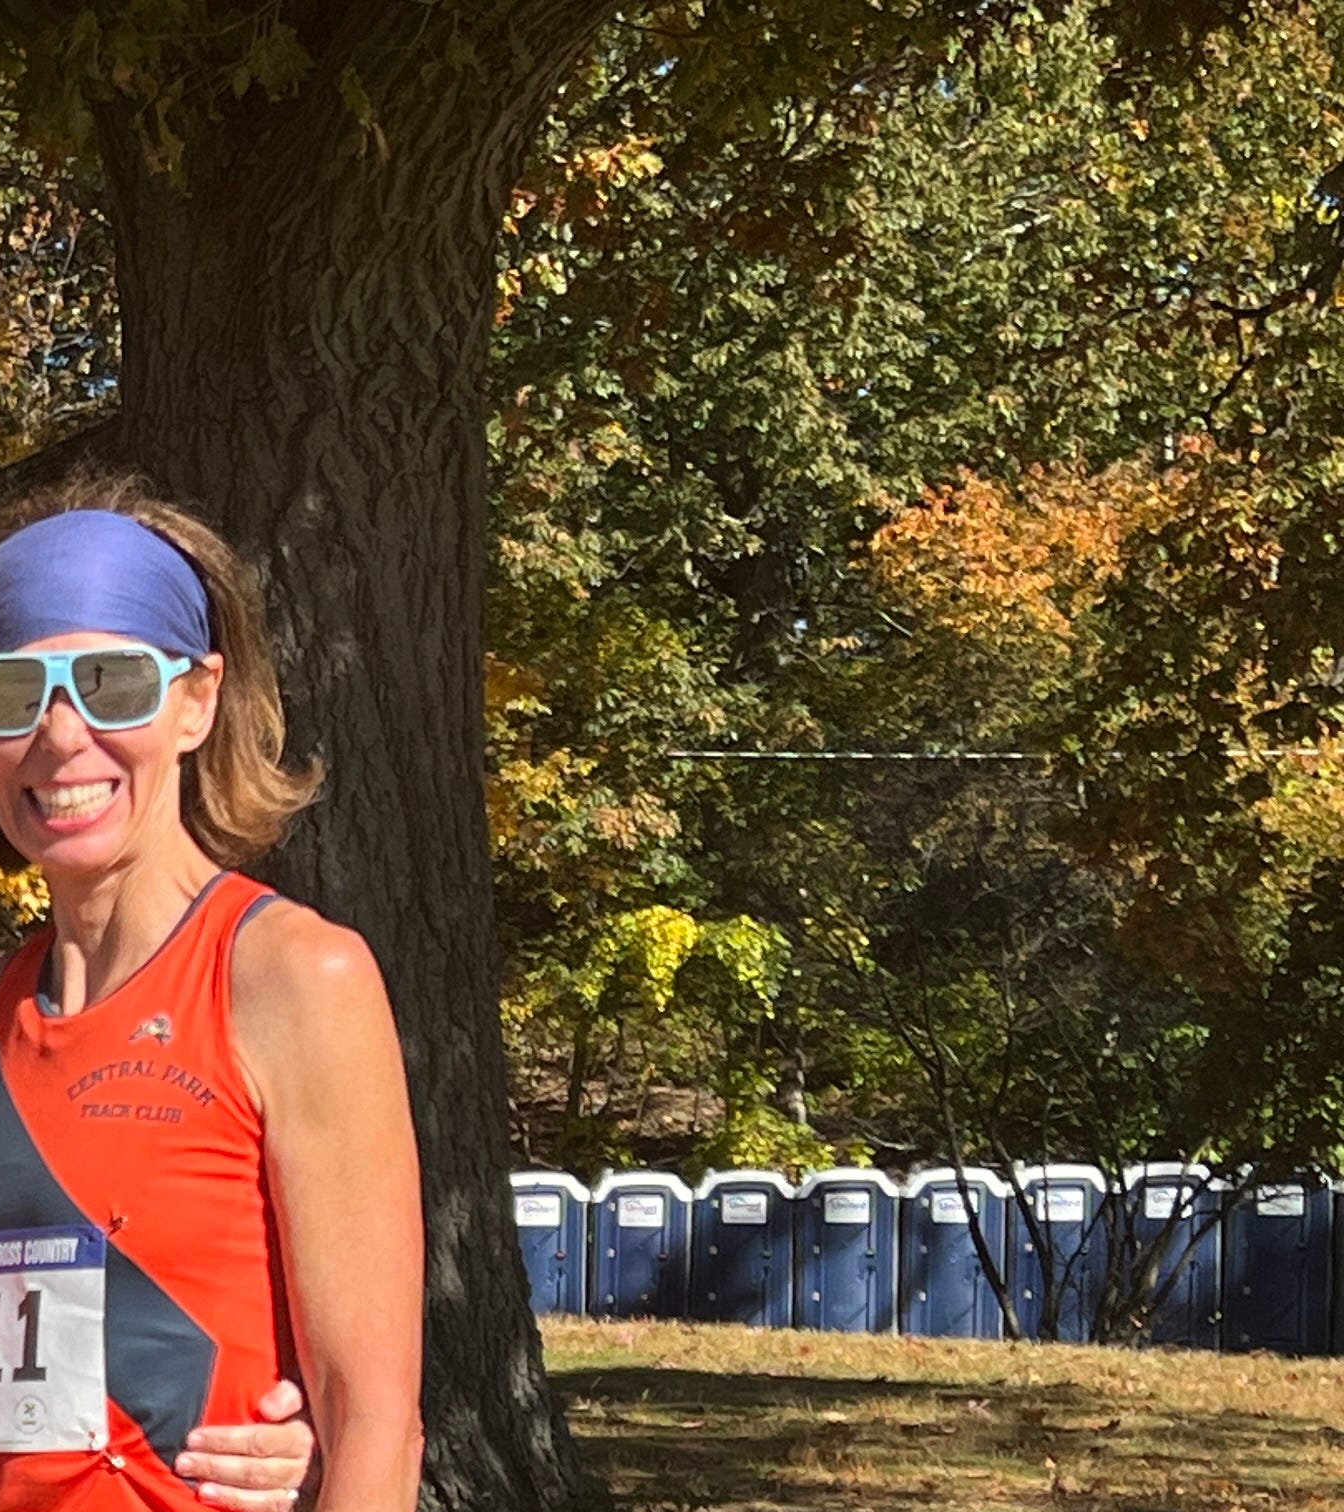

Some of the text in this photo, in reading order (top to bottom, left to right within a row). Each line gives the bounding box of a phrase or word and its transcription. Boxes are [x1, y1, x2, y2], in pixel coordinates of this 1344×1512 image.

[67, 1060, 217, 1108] CENTRAL PARK
[80, 1104, 182, 1123] TRACK CLUB
[24, 1237, 79, 1266] COUNTRY
